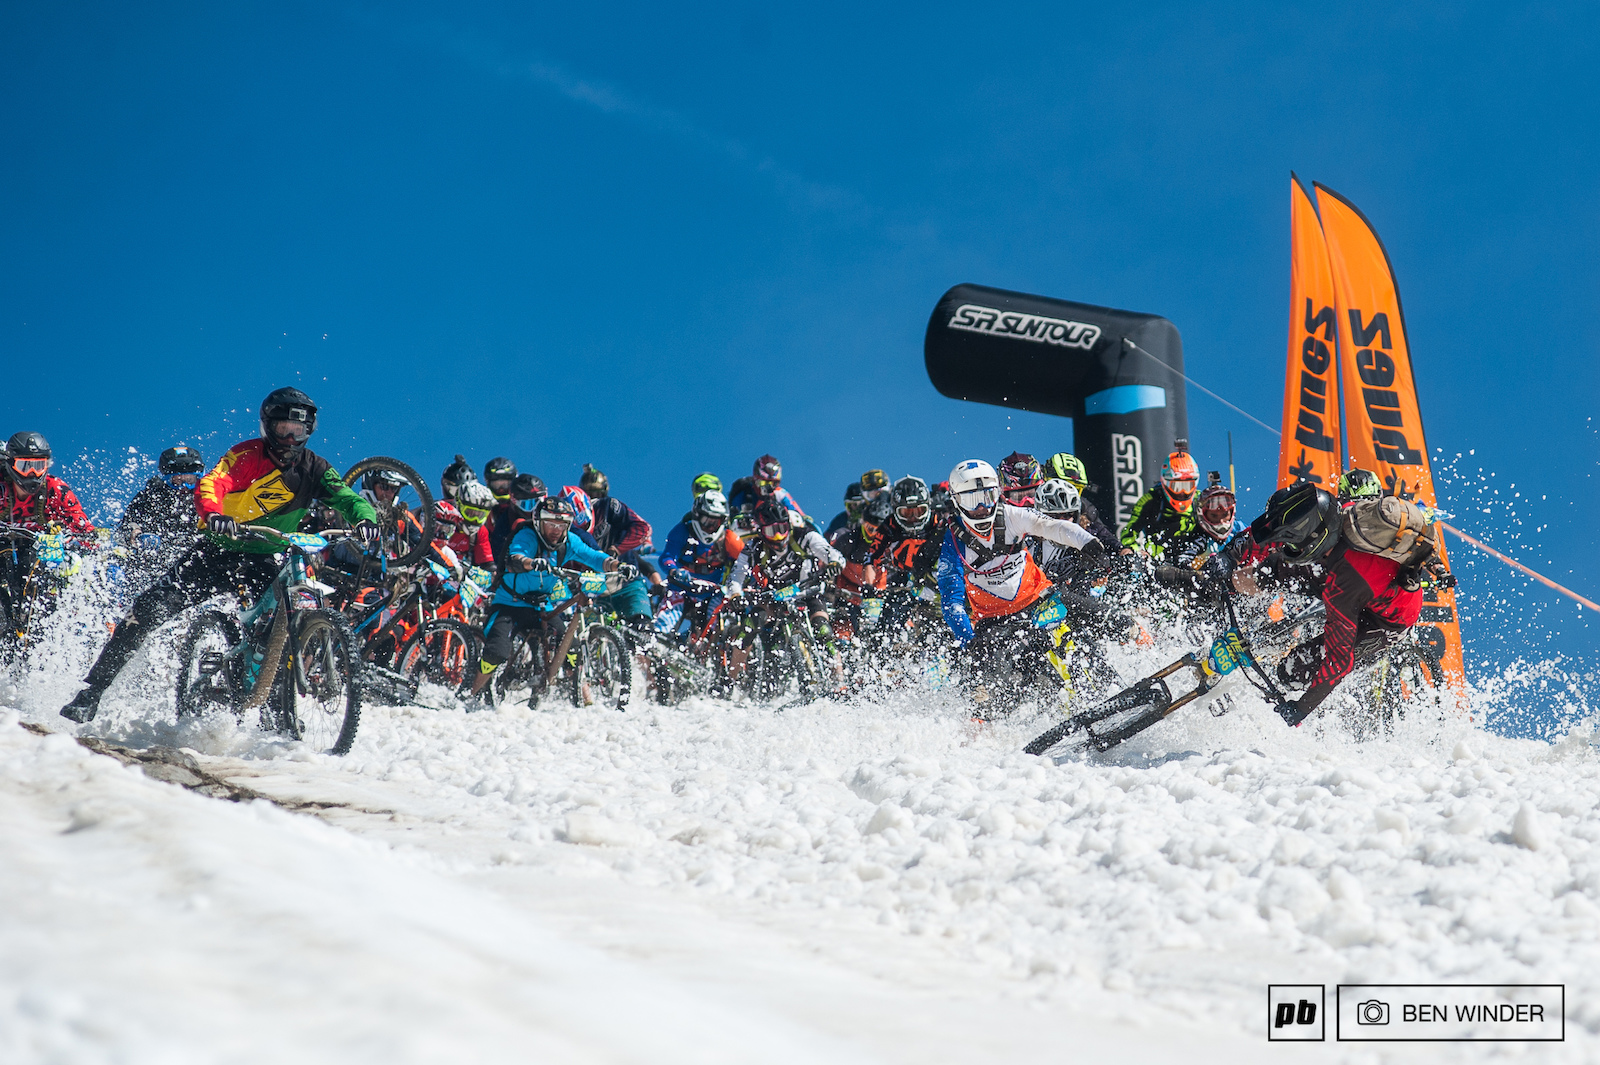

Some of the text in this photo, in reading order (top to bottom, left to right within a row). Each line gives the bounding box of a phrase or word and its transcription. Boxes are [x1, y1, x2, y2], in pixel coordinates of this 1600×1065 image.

[950, 306, 1099, 348] SR SUNTOUR
[1115, 437, 1139, 475] SR
[292, 536, 323, 545] 1430
[1038, 607, 1060, 623] 462
[1213, 642, 1232, 671] 1056
